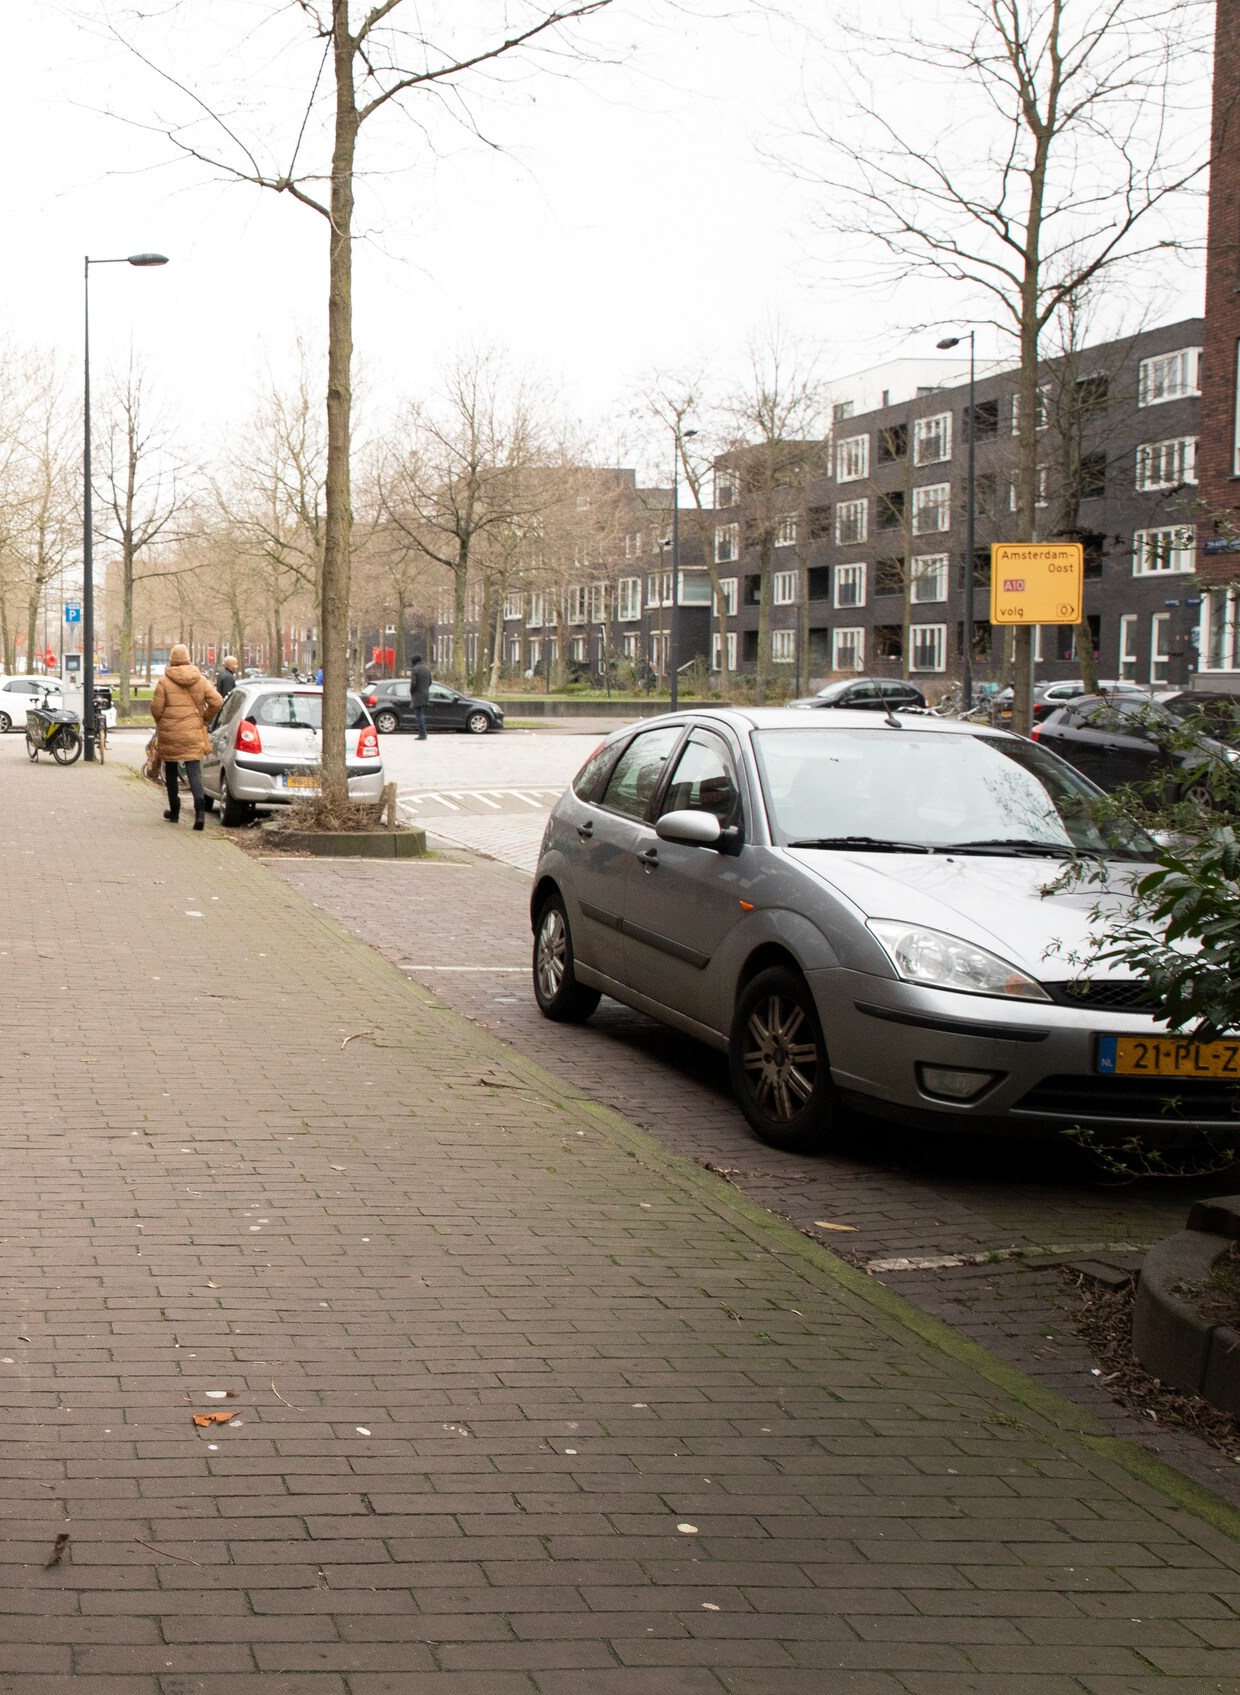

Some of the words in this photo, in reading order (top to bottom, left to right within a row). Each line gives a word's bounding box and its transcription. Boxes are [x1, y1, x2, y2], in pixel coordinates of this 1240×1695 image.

[1001, 550, 1075, 560] Amsterdam-
[1048, 563, 1074, 573] Oost
[1004, 581, 1024, 591] A10
[69, 610, 77, 621] P
[1000, 606, 1024, 618] volg
[1101, 1058, 1113, 1067] NL
